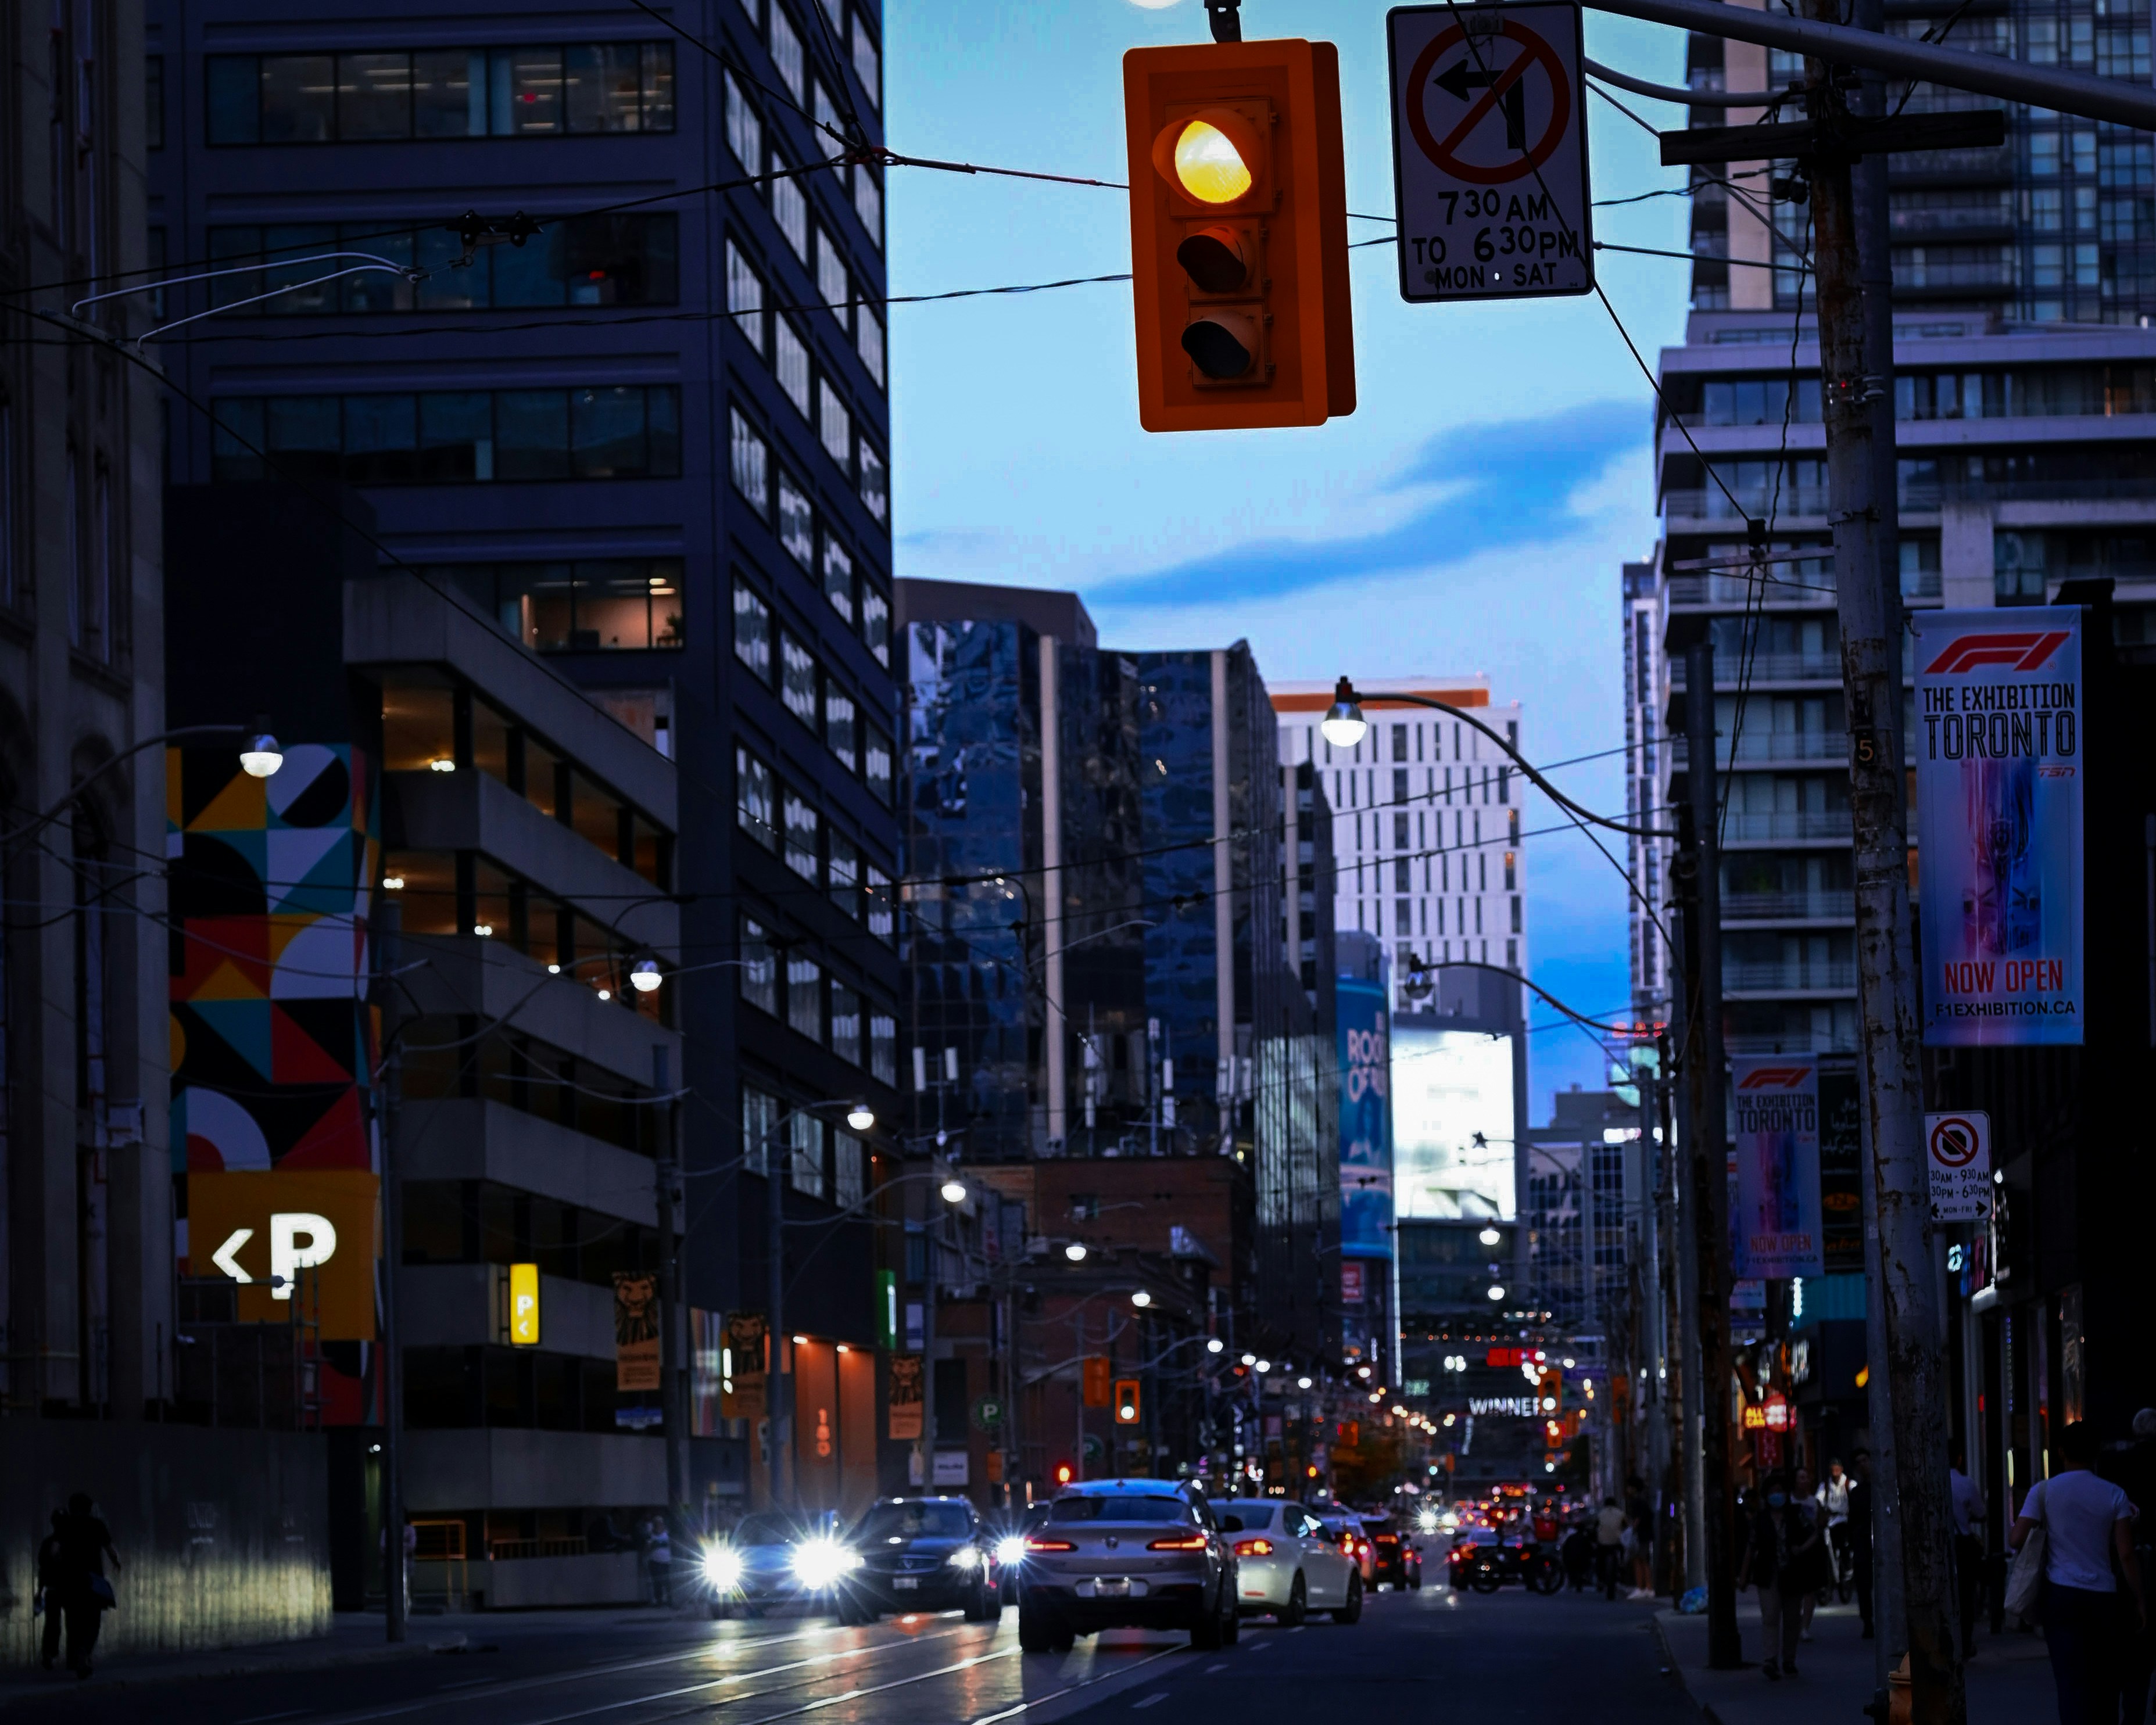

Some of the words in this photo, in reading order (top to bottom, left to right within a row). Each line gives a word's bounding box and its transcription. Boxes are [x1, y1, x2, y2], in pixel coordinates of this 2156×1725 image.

[1412, 237, 1446, 264] TO
[1435, 266, 1485, 289] MON
[1513, 263, 1557, 286] SAT
[1923, 687, 1954, 712] THE
[1962, 683, 2075, 711] EXHIBITION
[1924, 711, 2076, 760] TORONTO
[1858, 738, 1875, 763] 5
[2038, 767, 2076, 777] TSN
[1944, 962, 1996, 994] NOW
[2005, 959, 2063, 992] OPEN
[1936, 1000, 2076, 1017] F1EXHIBITION.CA
[1737, 1095, 1752, 1108] THE
[1757, 1093, 1815, 1107] EXHIBITION
[1737, 1108, 1815, 1133] TORONTO
[1751, 1235, 1777, 1253] NOW
[1782, 1233, 1812, 1252] OPEN
[270, 1213, 336, 1300] P
[517, 1296, 533, 1316] P
[982, 1403, 998, 1420] P
